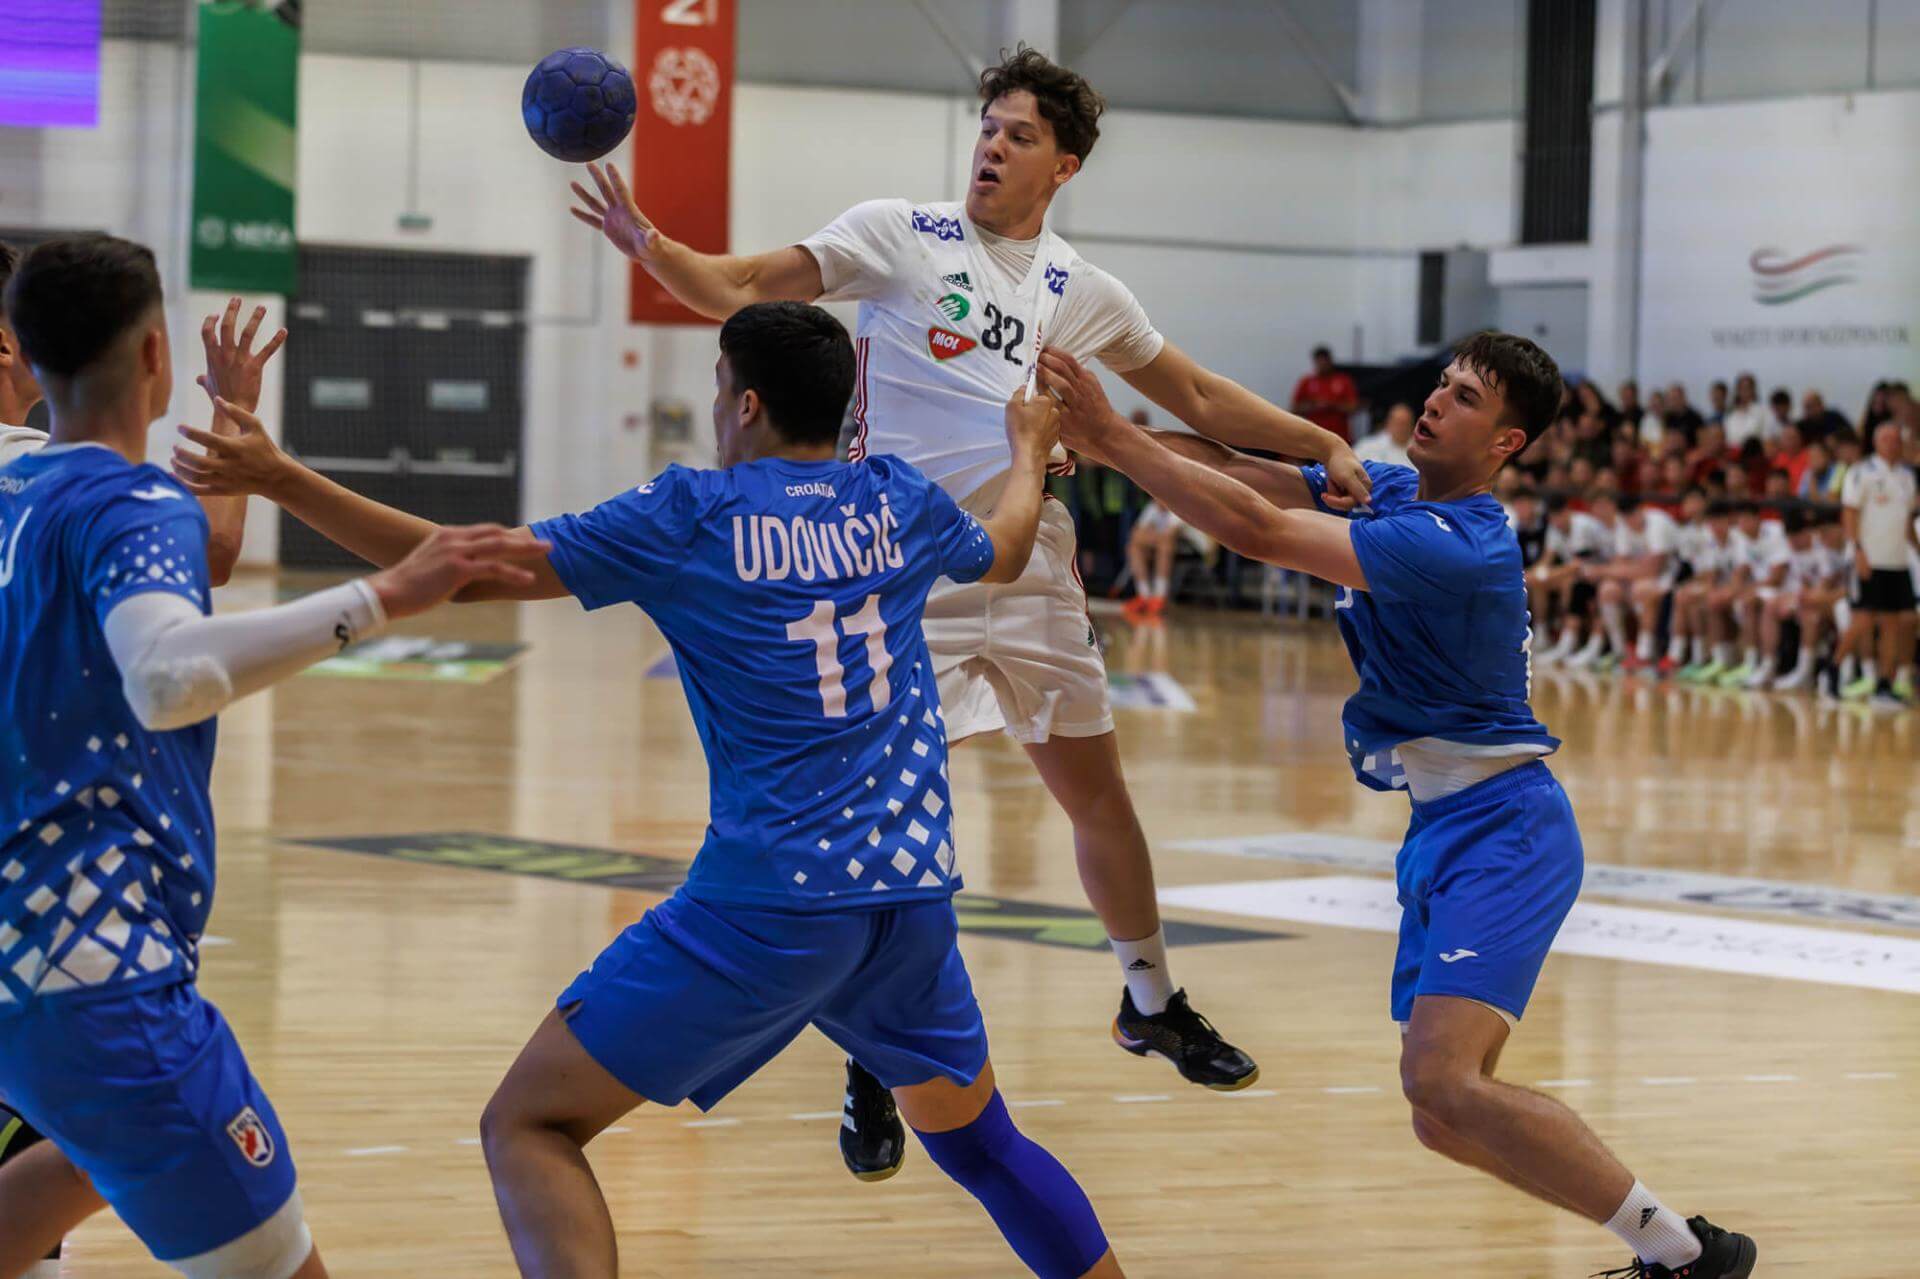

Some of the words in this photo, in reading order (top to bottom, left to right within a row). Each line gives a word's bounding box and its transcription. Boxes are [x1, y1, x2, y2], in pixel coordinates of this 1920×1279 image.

[982, 301, 1025, 367] 32
[785, 482, 837, 499] CROATIA
[733, 493, 904, 582] UDOVIČIĆ
[785, 594, 894, 717] 11
